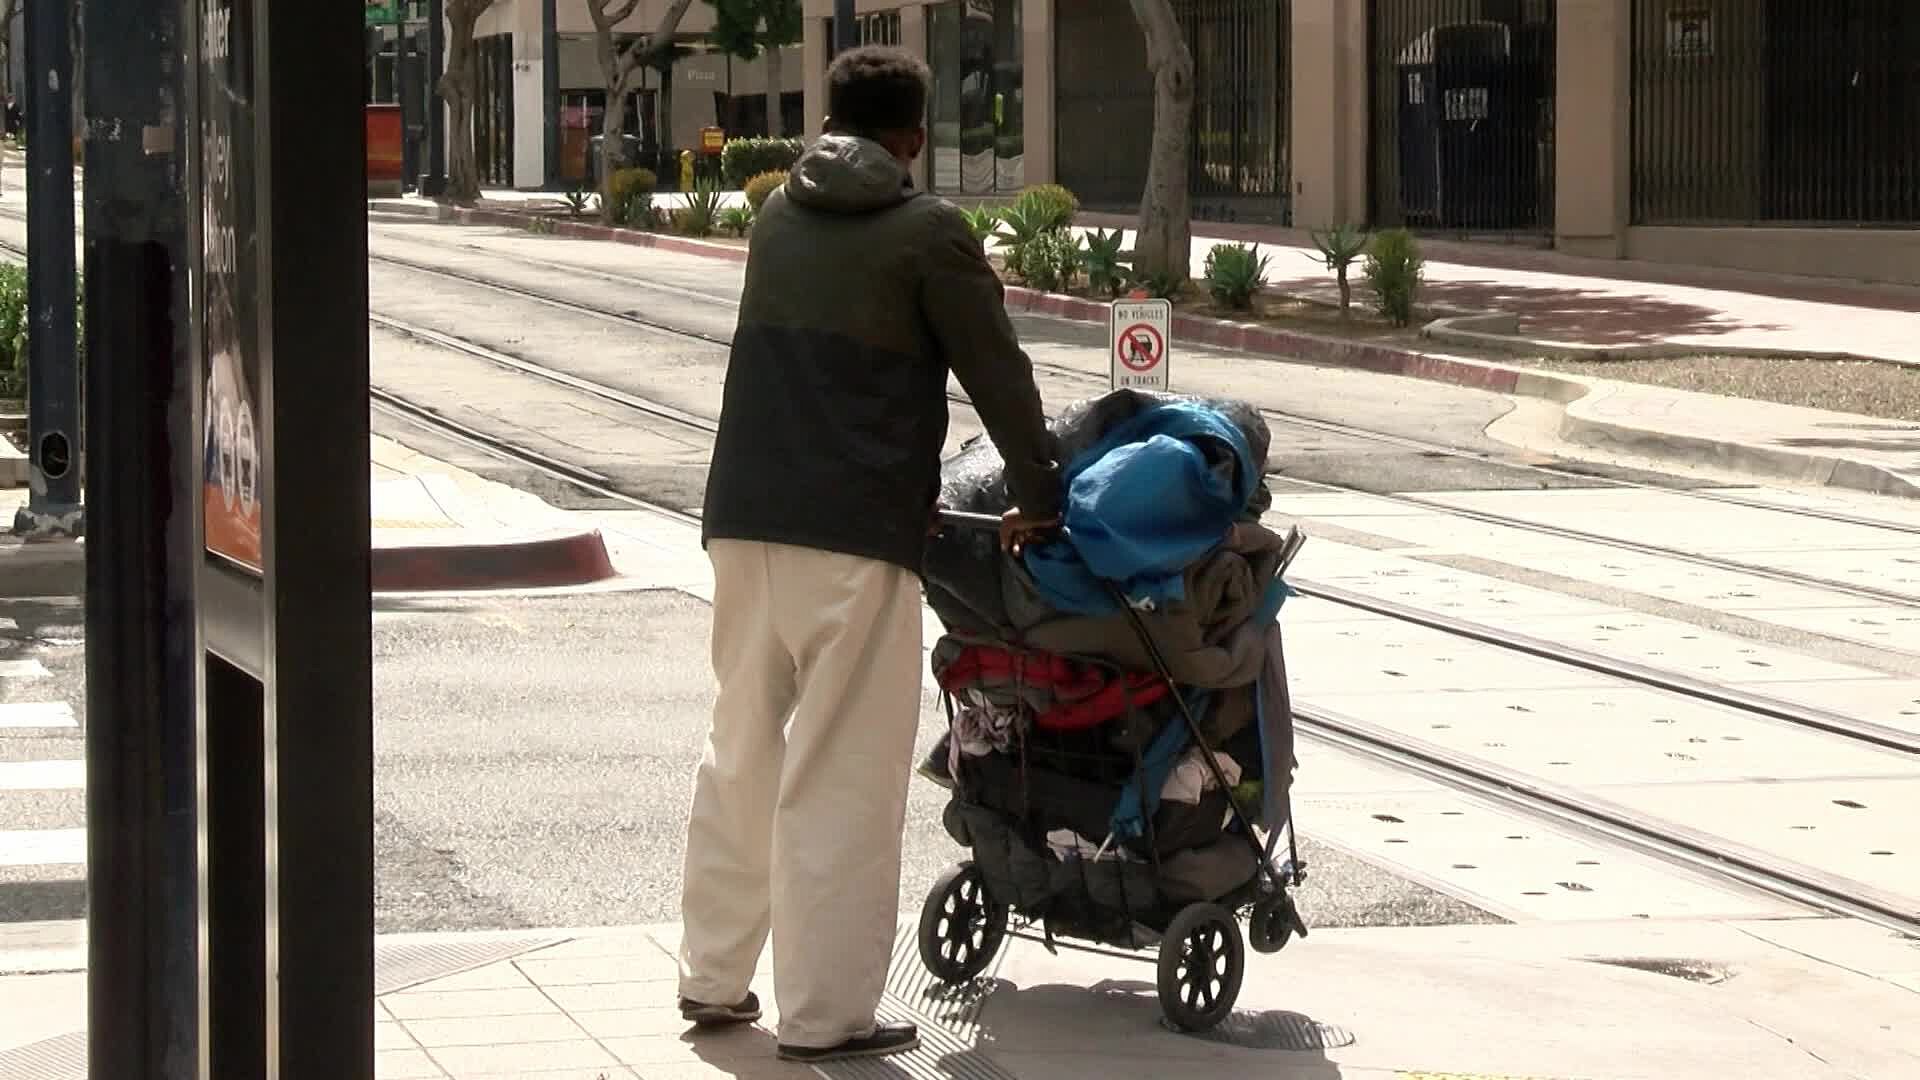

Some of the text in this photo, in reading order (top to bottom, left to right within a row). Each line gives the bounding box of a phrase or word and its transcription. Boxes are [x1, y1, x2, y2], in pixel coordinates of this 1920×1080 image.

[1118, 310, 1163, 320] NO VEHICLES
[1120, 375, 1160, 385] ON TRACKS
